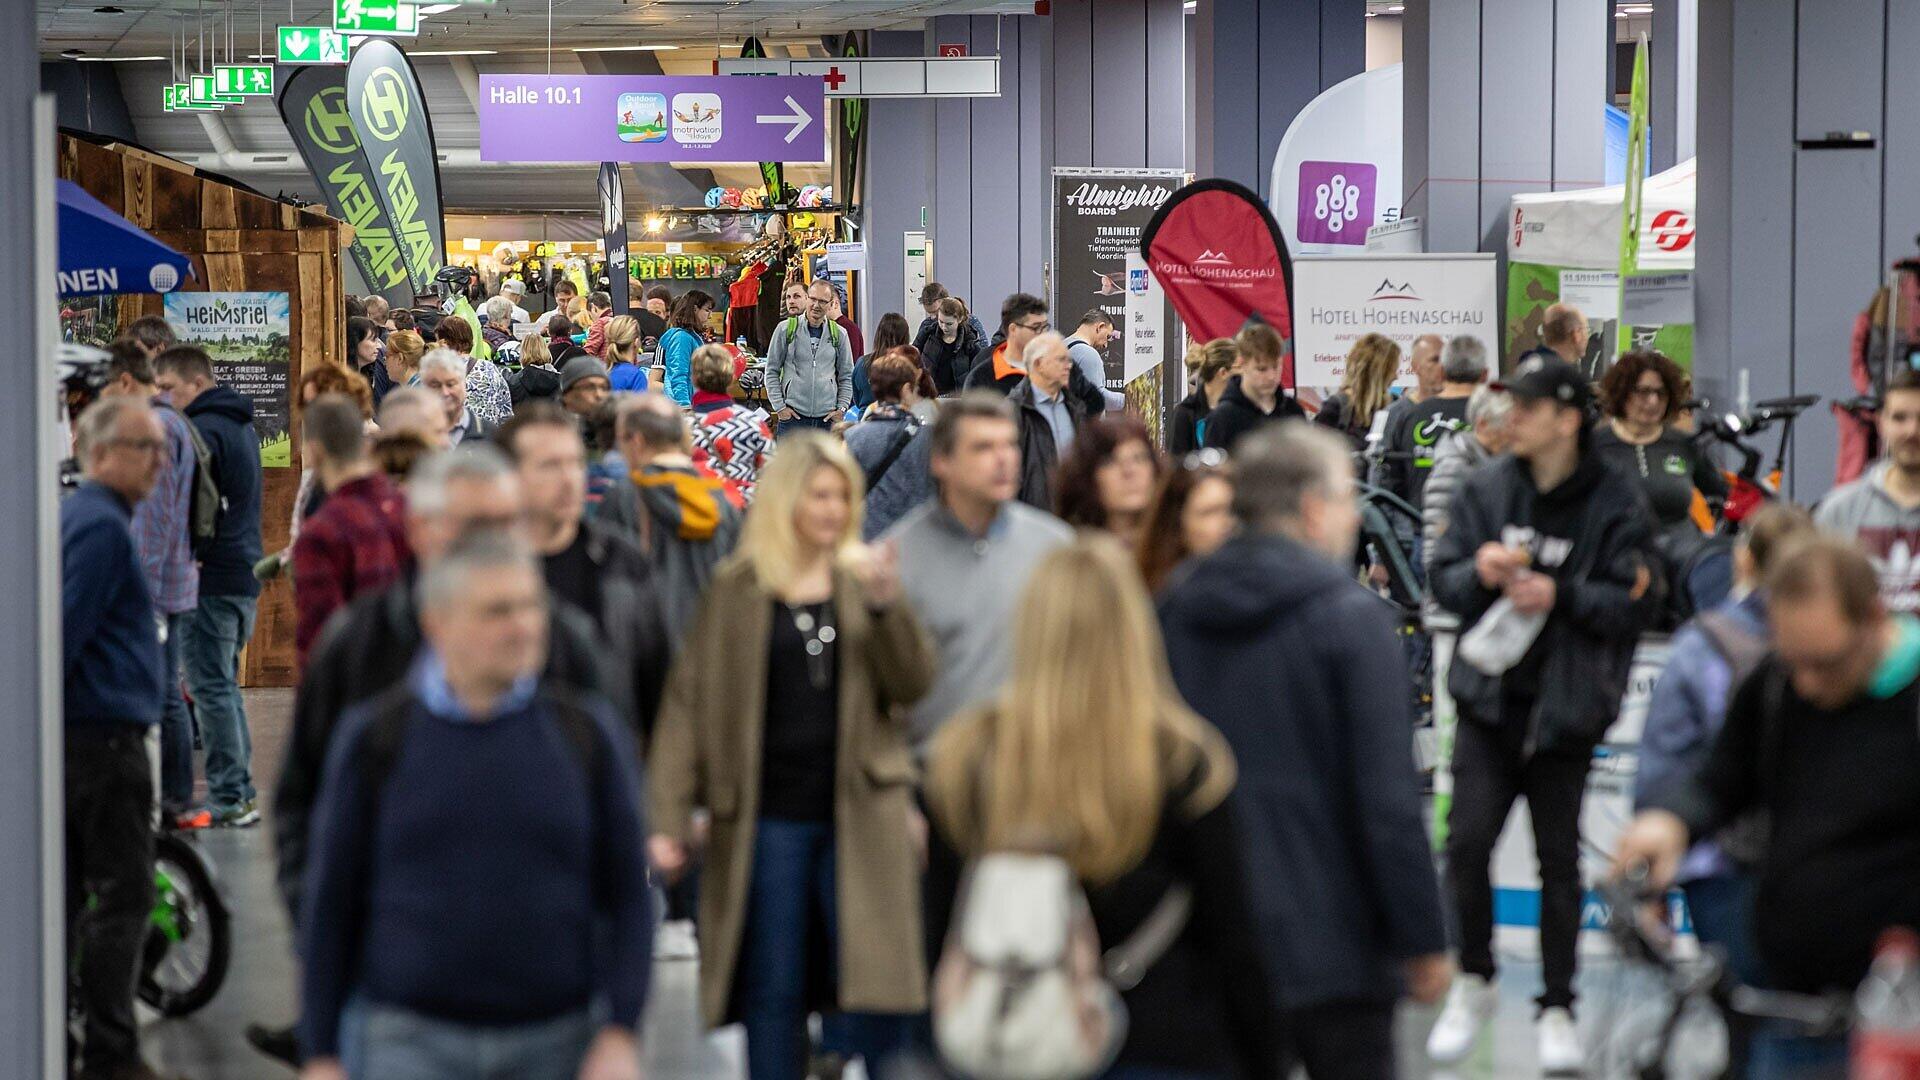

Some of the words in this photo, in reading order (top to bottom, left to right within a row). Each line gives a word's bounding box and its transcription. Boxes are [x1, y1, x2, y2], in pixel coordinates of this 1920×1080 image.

[490, 85, 539, 104] Halle
[544, 86, 581, 104] 10.1
[673, 125, 720, 135] motrivation
[1066, 182, 1173, 211] Almighty
[1078, 207, 1117, 216] BOARDS
[1096, 226, 1141, 236] TRAINIERT
[1094, 237, 1142, 246] Gleichgewich
[57, 267, 119, 293] NEN
[1311, 307, 1358, 325] HOTEL
[1364, 307, 1483, 325] HOHENASCHAU
